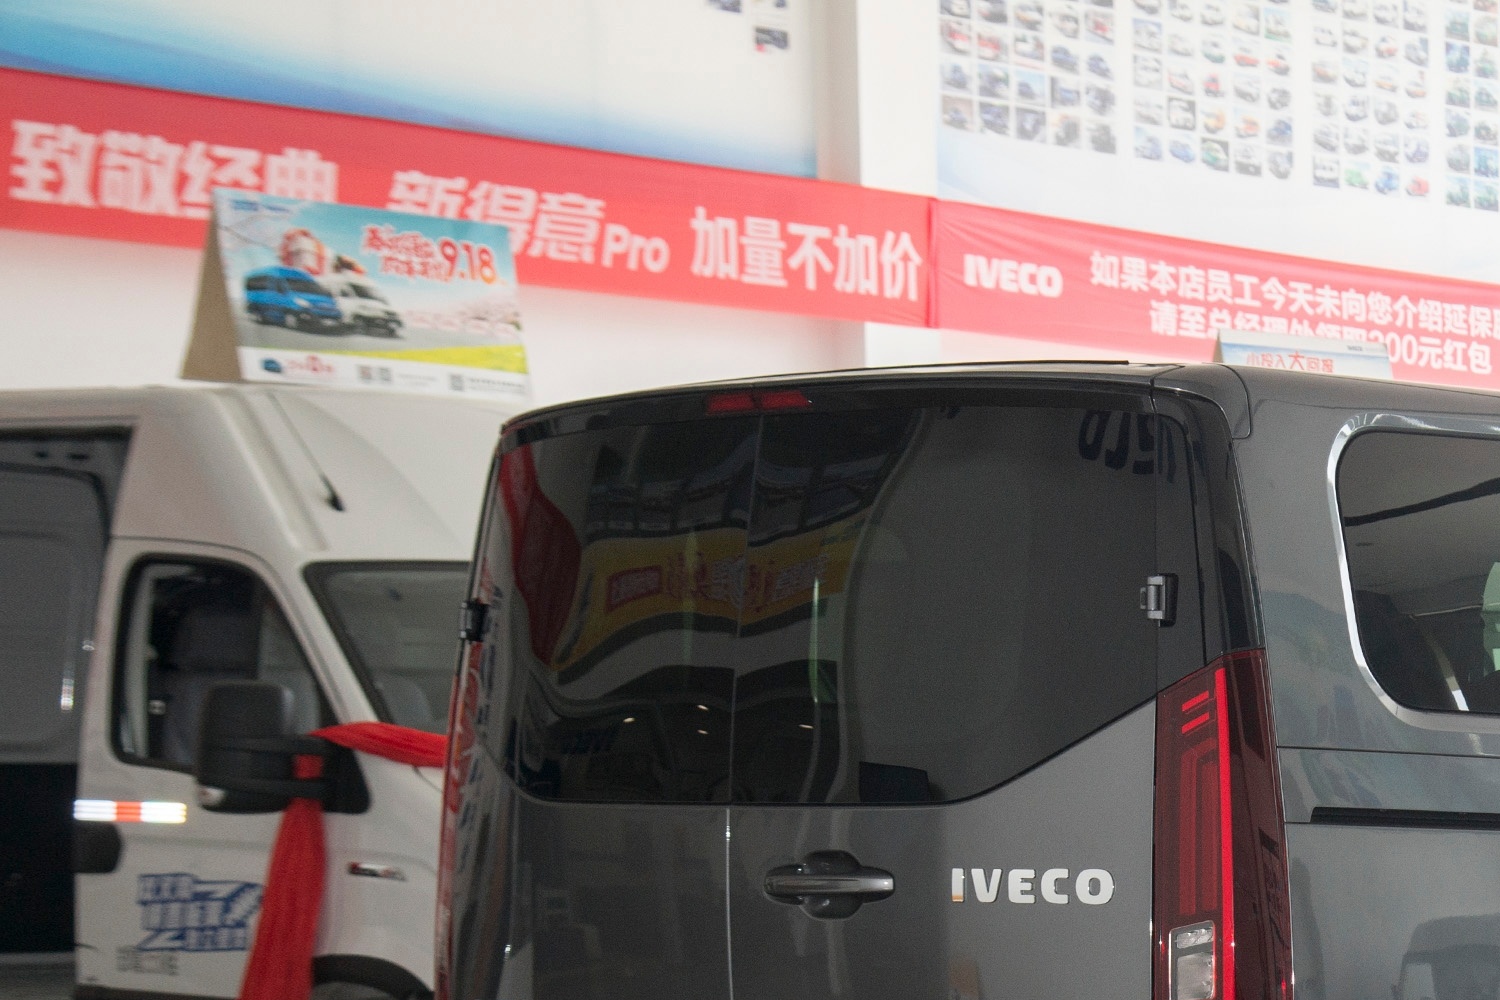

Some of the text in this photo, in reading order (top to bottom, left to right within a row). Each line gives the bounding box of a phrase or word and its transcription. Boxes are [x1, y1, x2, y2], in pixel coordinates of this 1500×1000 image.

[9, 119, 338, 219] 致敬经典
[689, 205, 923, 302] 加量不加价
[963, 253, 1064, 298] IVECO
[951, 868, 1116, 905] IVECO
